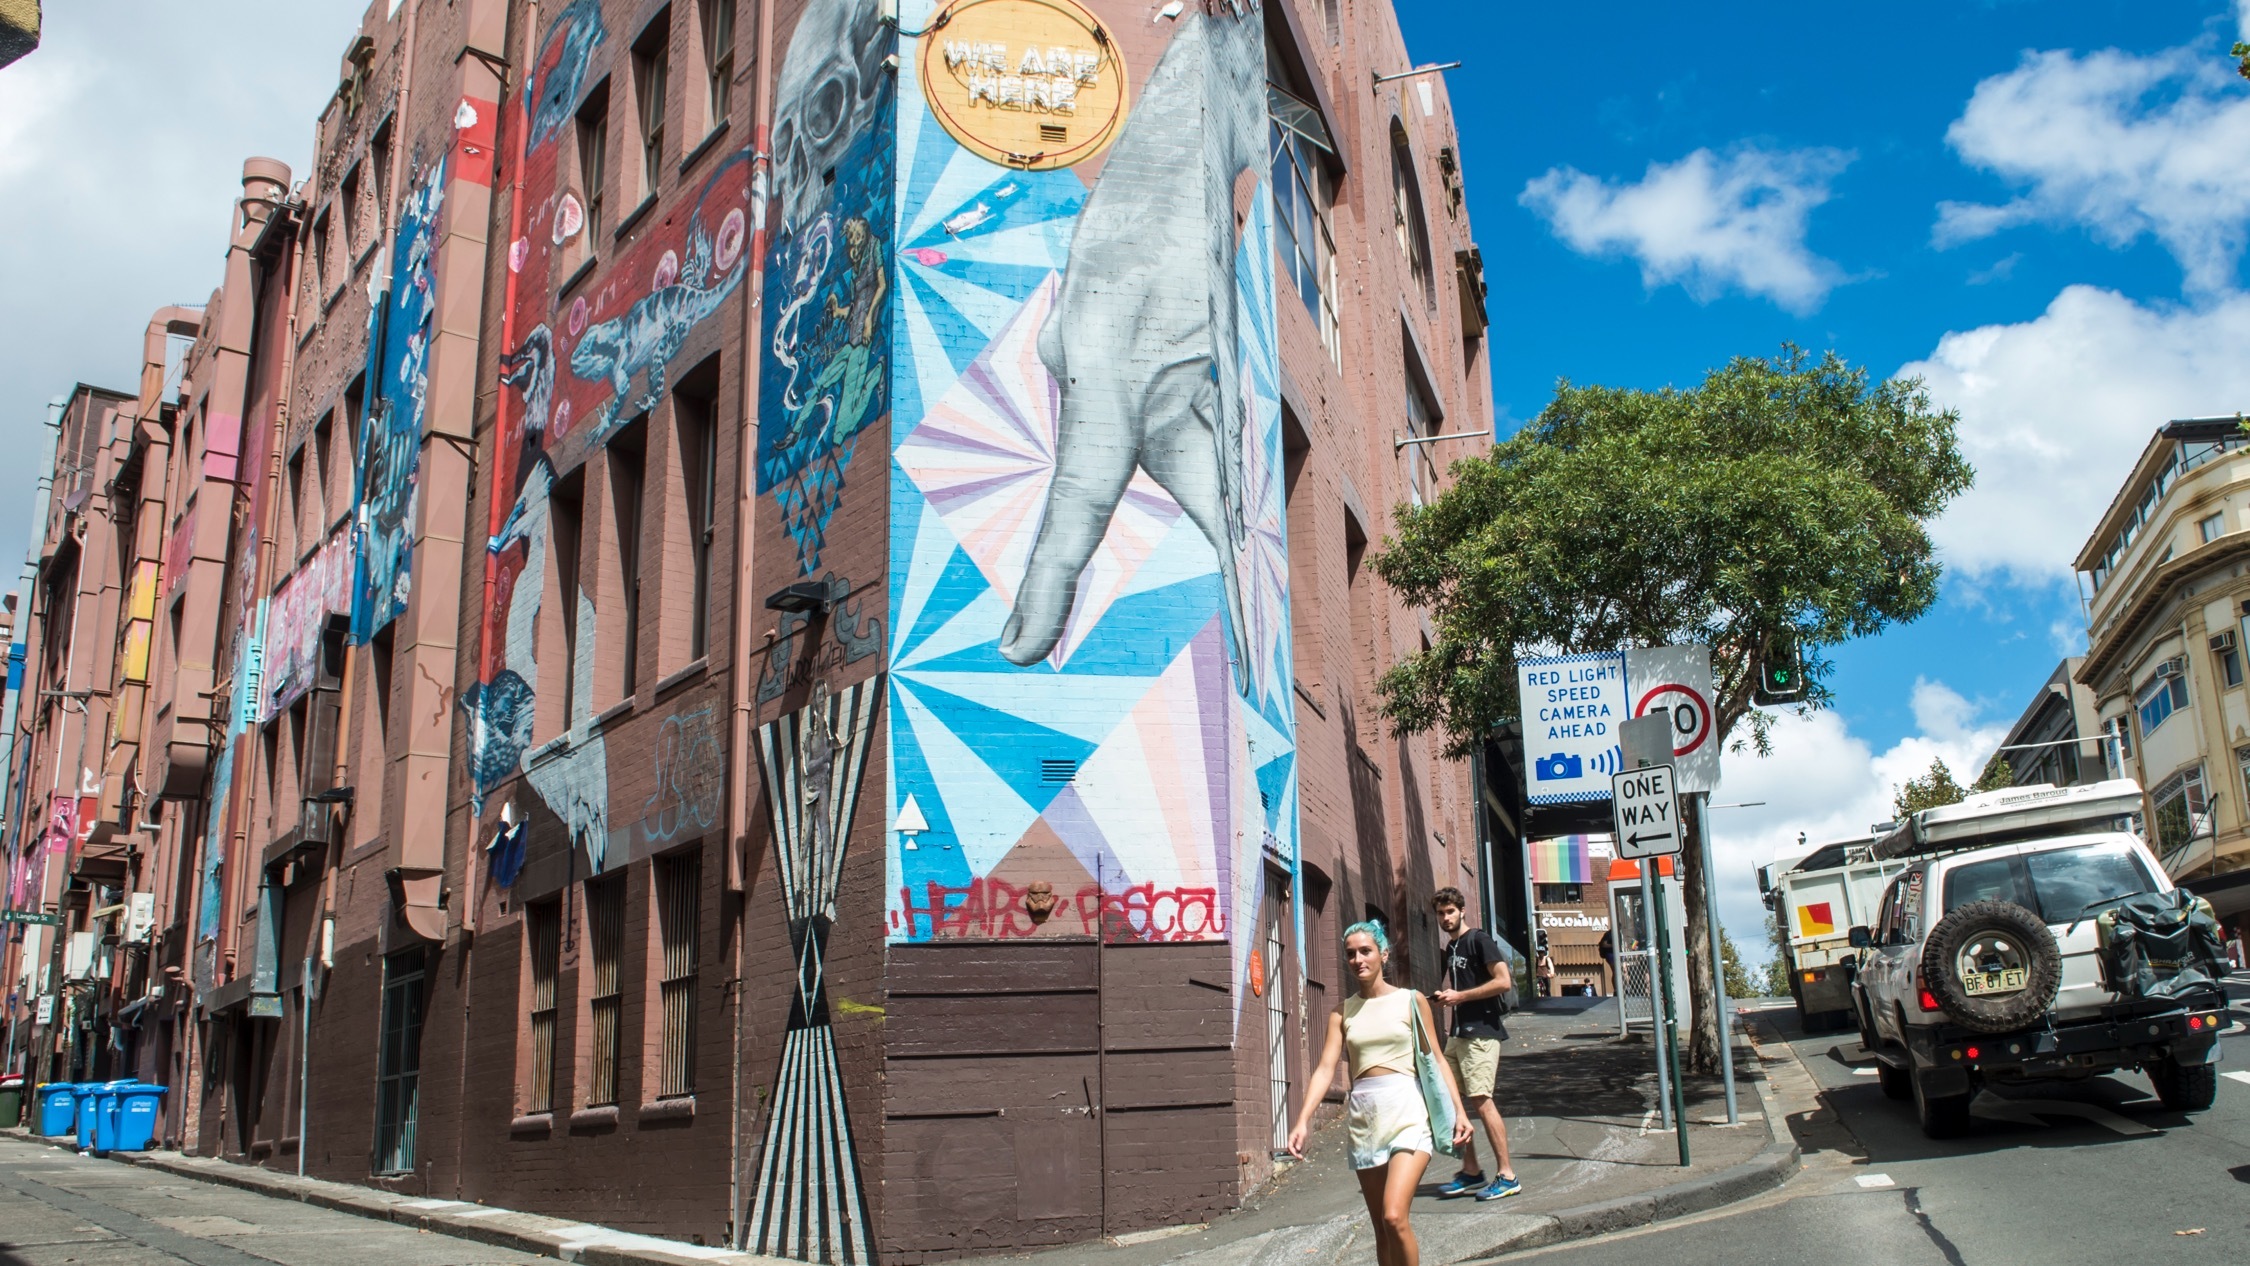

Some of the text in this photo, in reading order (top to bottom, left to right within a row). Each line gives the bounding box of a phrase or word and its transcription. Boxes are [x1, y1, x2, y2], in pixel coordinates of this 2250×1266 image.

[943, 38, 1099, 82] WE ARE
[969, 71, 1076, 110] HERE
[1528, 666, 1617, 686] RED LIGHT
[1547, 686, 1601, 703] SPEED
[1539, 703, 1611, 722] CAMERA
[1651, 703, 1697, 734] 0
[1548, 722, 1606, 740] AHEAD
[1622, 775, 1665, 800] ONE
[1999, 788, 2068, 804] James Baroud
[1622, 802, 1669, 827] WAY
[16, 912, 40, 921] Langley
[1542, 916, 1609, 927] COLOMBIAN
[1965, 971, 2022, 991] BF 87 ET
